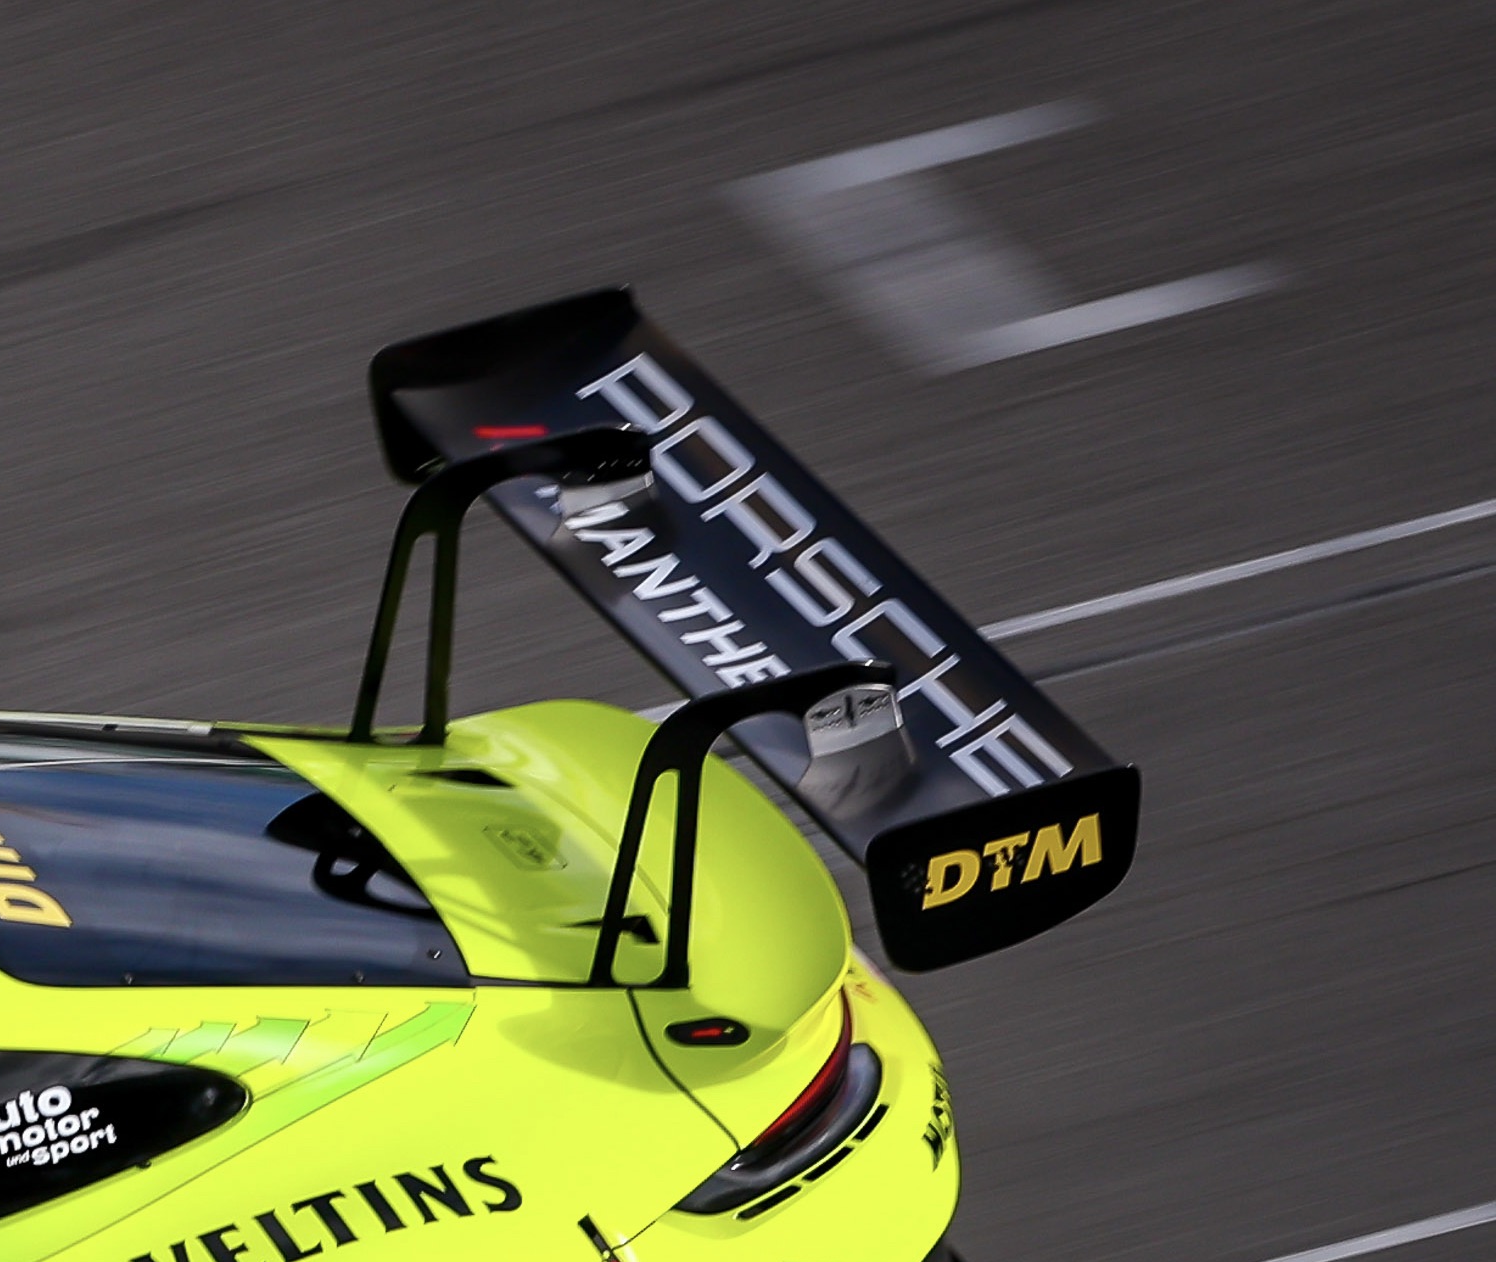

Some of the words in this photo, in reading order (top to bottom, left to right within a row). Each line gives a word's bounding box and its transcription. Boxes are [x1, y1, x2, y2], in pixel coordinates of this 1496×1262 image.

[576, 353, 1074, 796] PORSCHE
[921, 812, 1102, 911] DTM
[31, 1123, 118, 1166] sport
